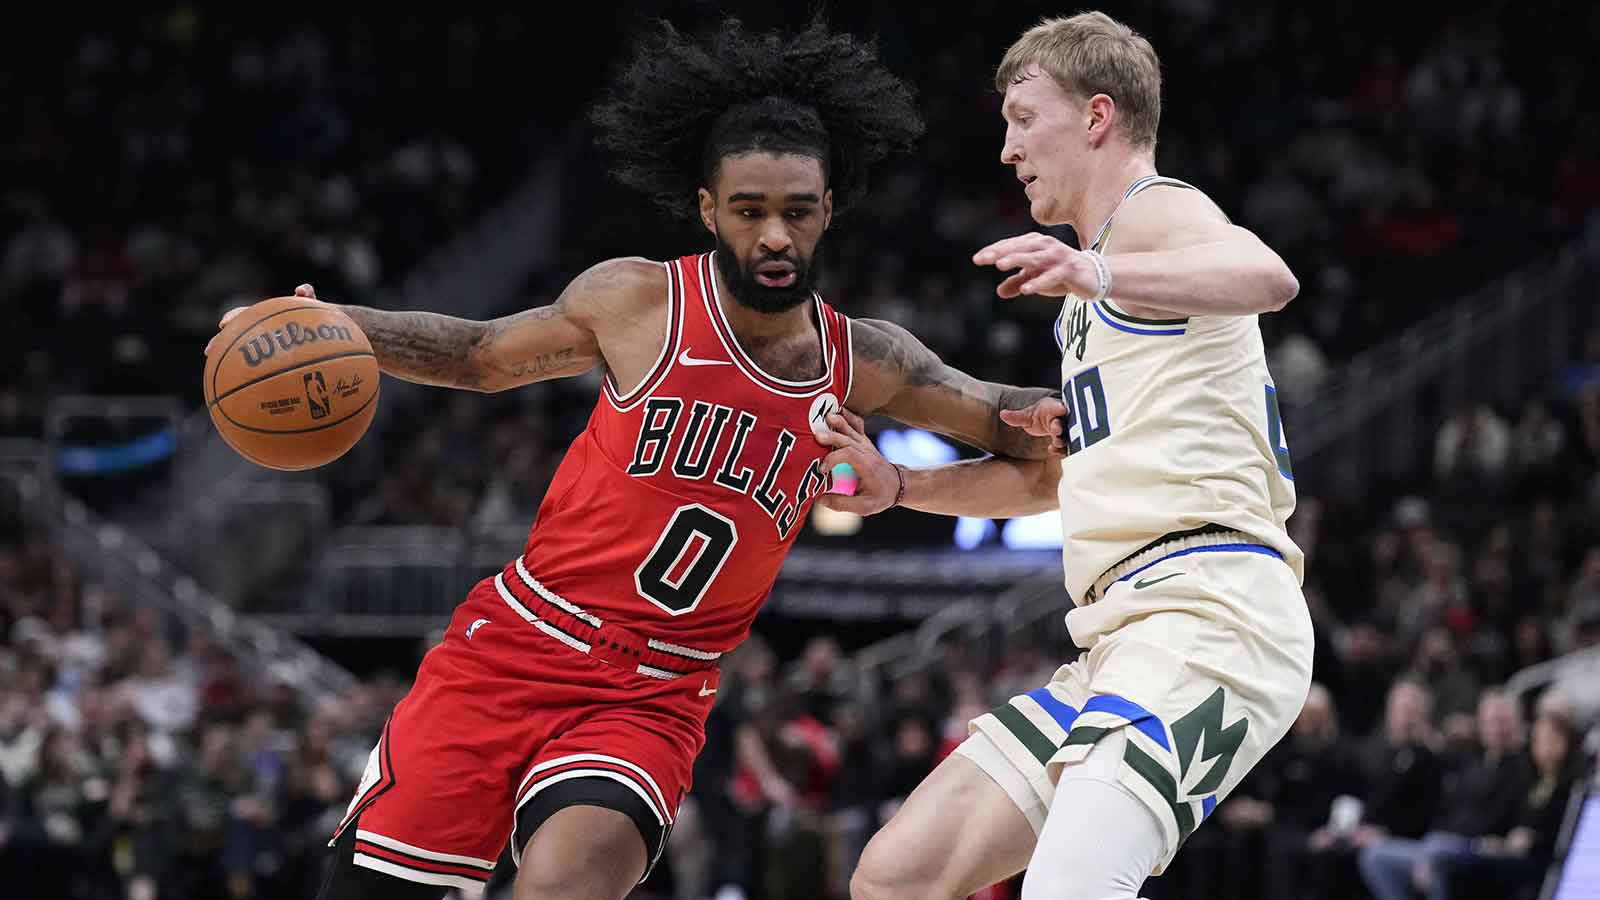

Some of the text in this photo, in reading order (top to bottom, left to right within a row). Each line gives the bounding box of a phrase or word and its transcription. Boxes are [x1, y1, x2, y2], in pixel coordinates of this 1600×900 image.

[239, 321, 353, 367] Wilson
[1063, 300, 1092, 361] ity
[1063, 366, 1112, 455] 20
[625, 396, 829, 541] BULLS
[634, 502, 738, 616] 0
